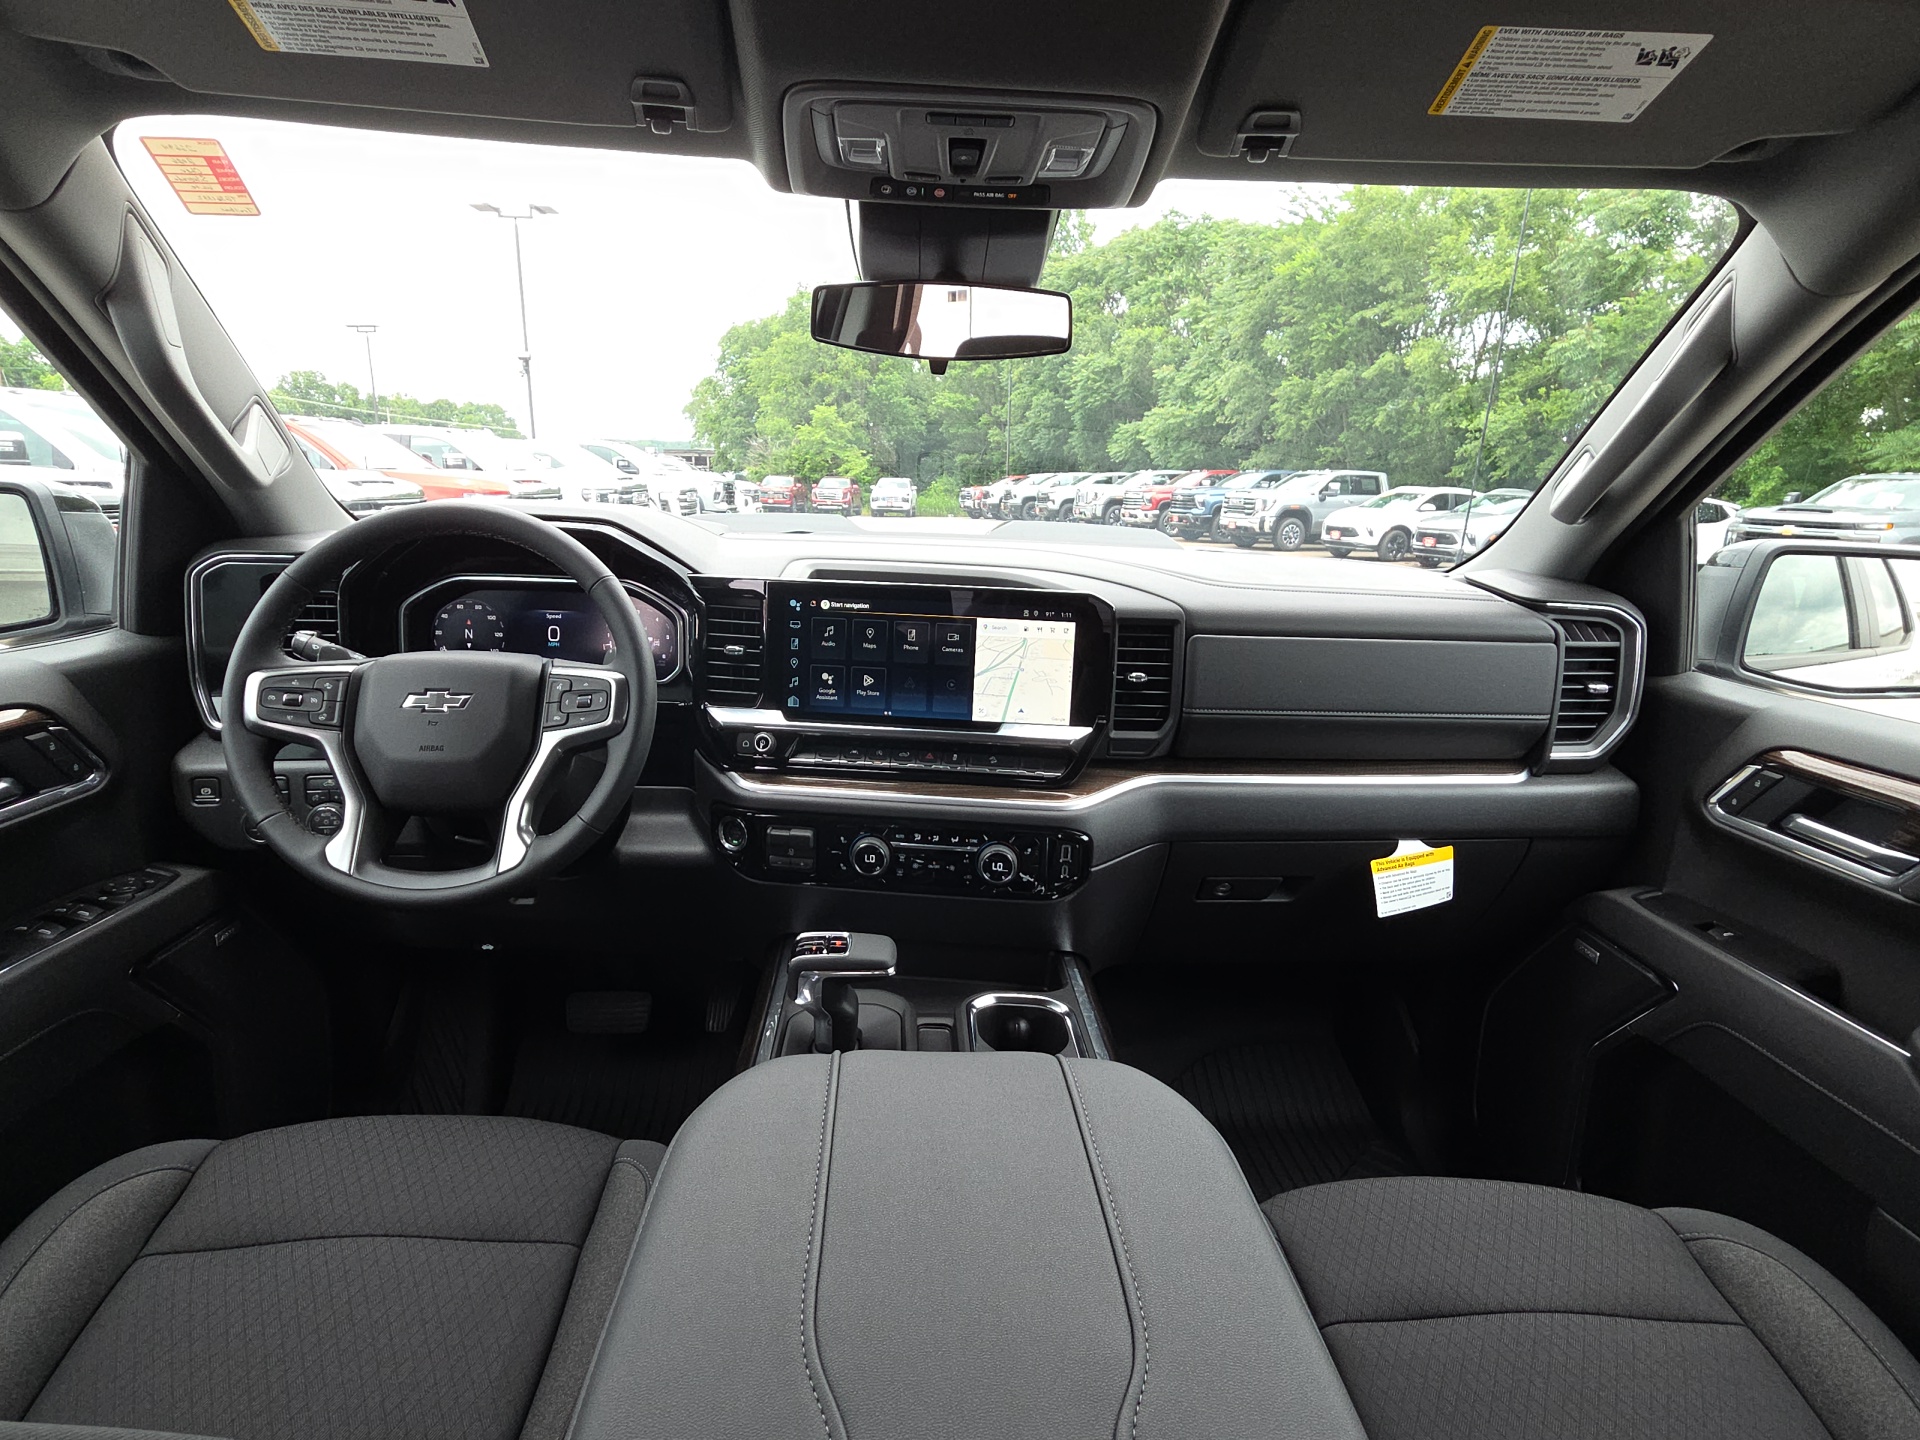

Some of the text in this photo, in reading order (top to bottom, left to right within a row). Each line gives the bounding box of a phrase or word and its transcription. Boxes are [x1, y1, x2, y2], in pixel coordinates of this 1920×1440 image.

[337, 8, 387, 18] GONFLABLES
[388, 12, 441, 23] INTELLIGENTS
[1542, 29, 1586, 37] ADVANCED
[1467, 30, 1492, 59] WARNING
[1470, 70, 1491, 78] MÊME
[1546, 74, 1590, 82] GONFLABLES
[1591, 76, 1641, 84] INTELLIGENTS
[844, 602, 870, 610] navigation
[464, 628, 473, 639] N
[547, 625, 561, 642] 0
[863, 642, 877, 650] Maps
[419, 744, 444, 752] AIRBAG
[864, 854, 876, 863] LO
[1405, 853, 1425, 862] Equipped
[1376, 864, 1397, 872] Advanced
